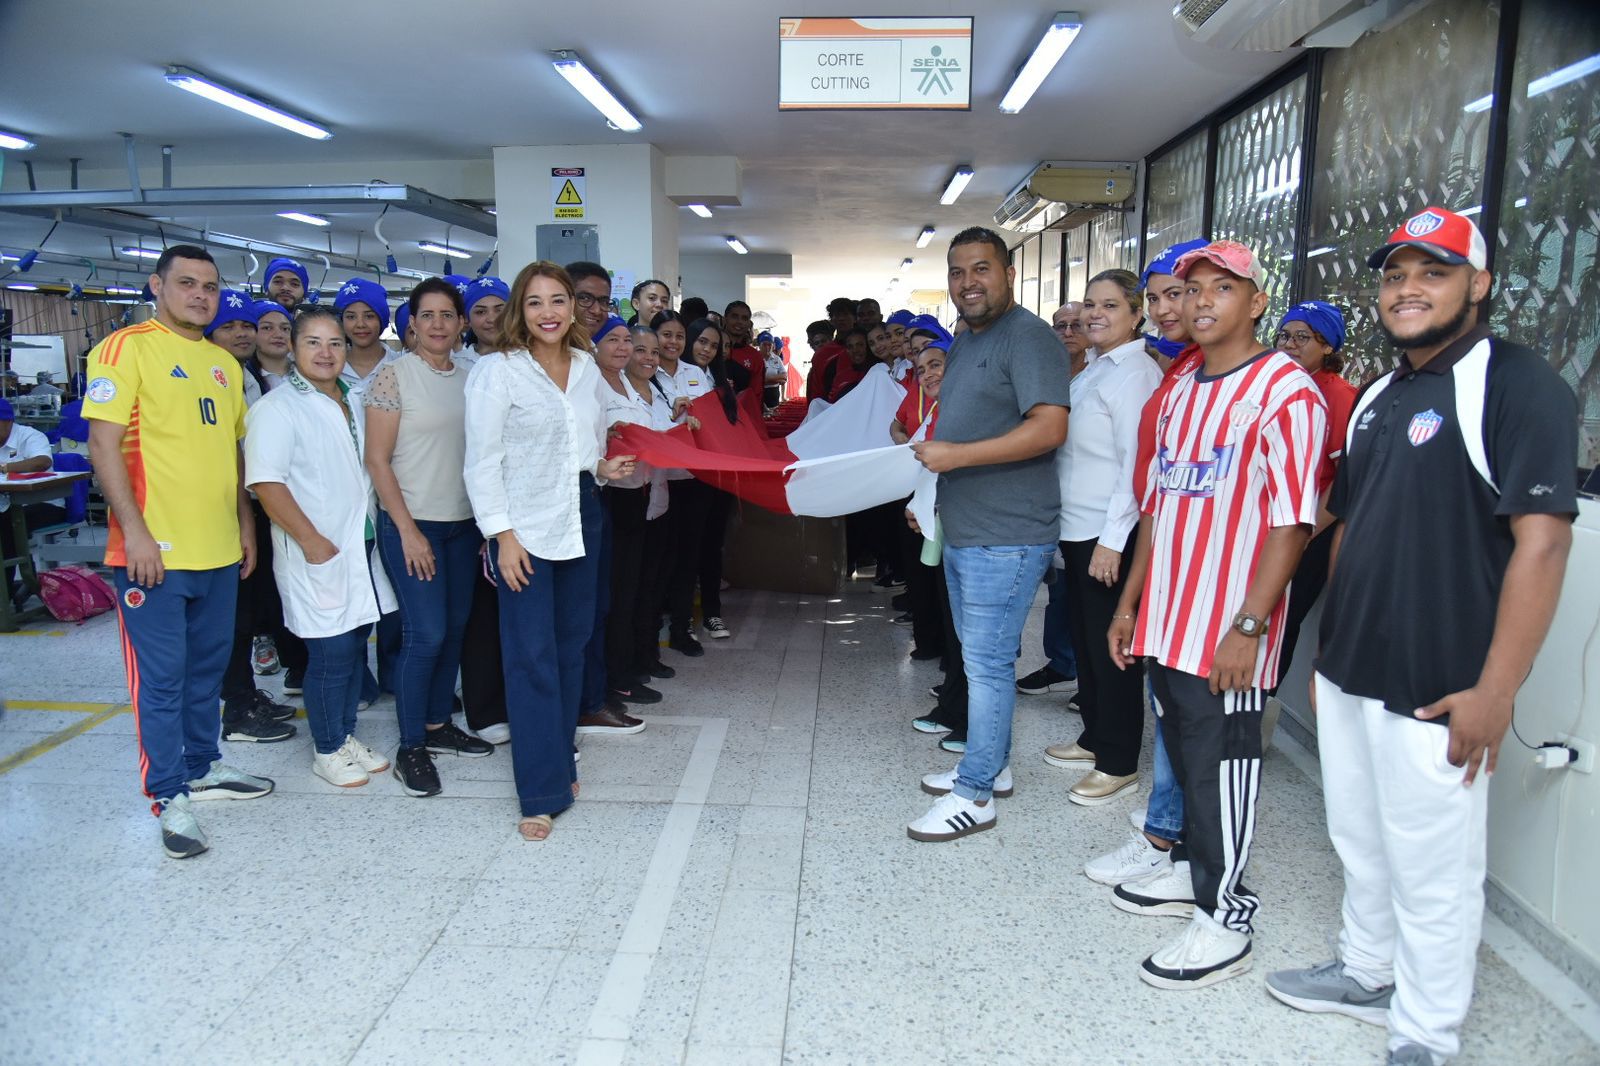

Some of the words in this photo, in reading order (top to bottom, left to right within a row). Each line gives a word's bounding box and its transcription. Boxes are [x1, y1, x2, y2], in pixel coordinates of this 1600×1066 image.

[818, 53, 864, 66] CORTE
[913, 58, 959, 67] SENA
[811, 76, 870, 90] CUTTING
[199, 397, 217, 425] 10
